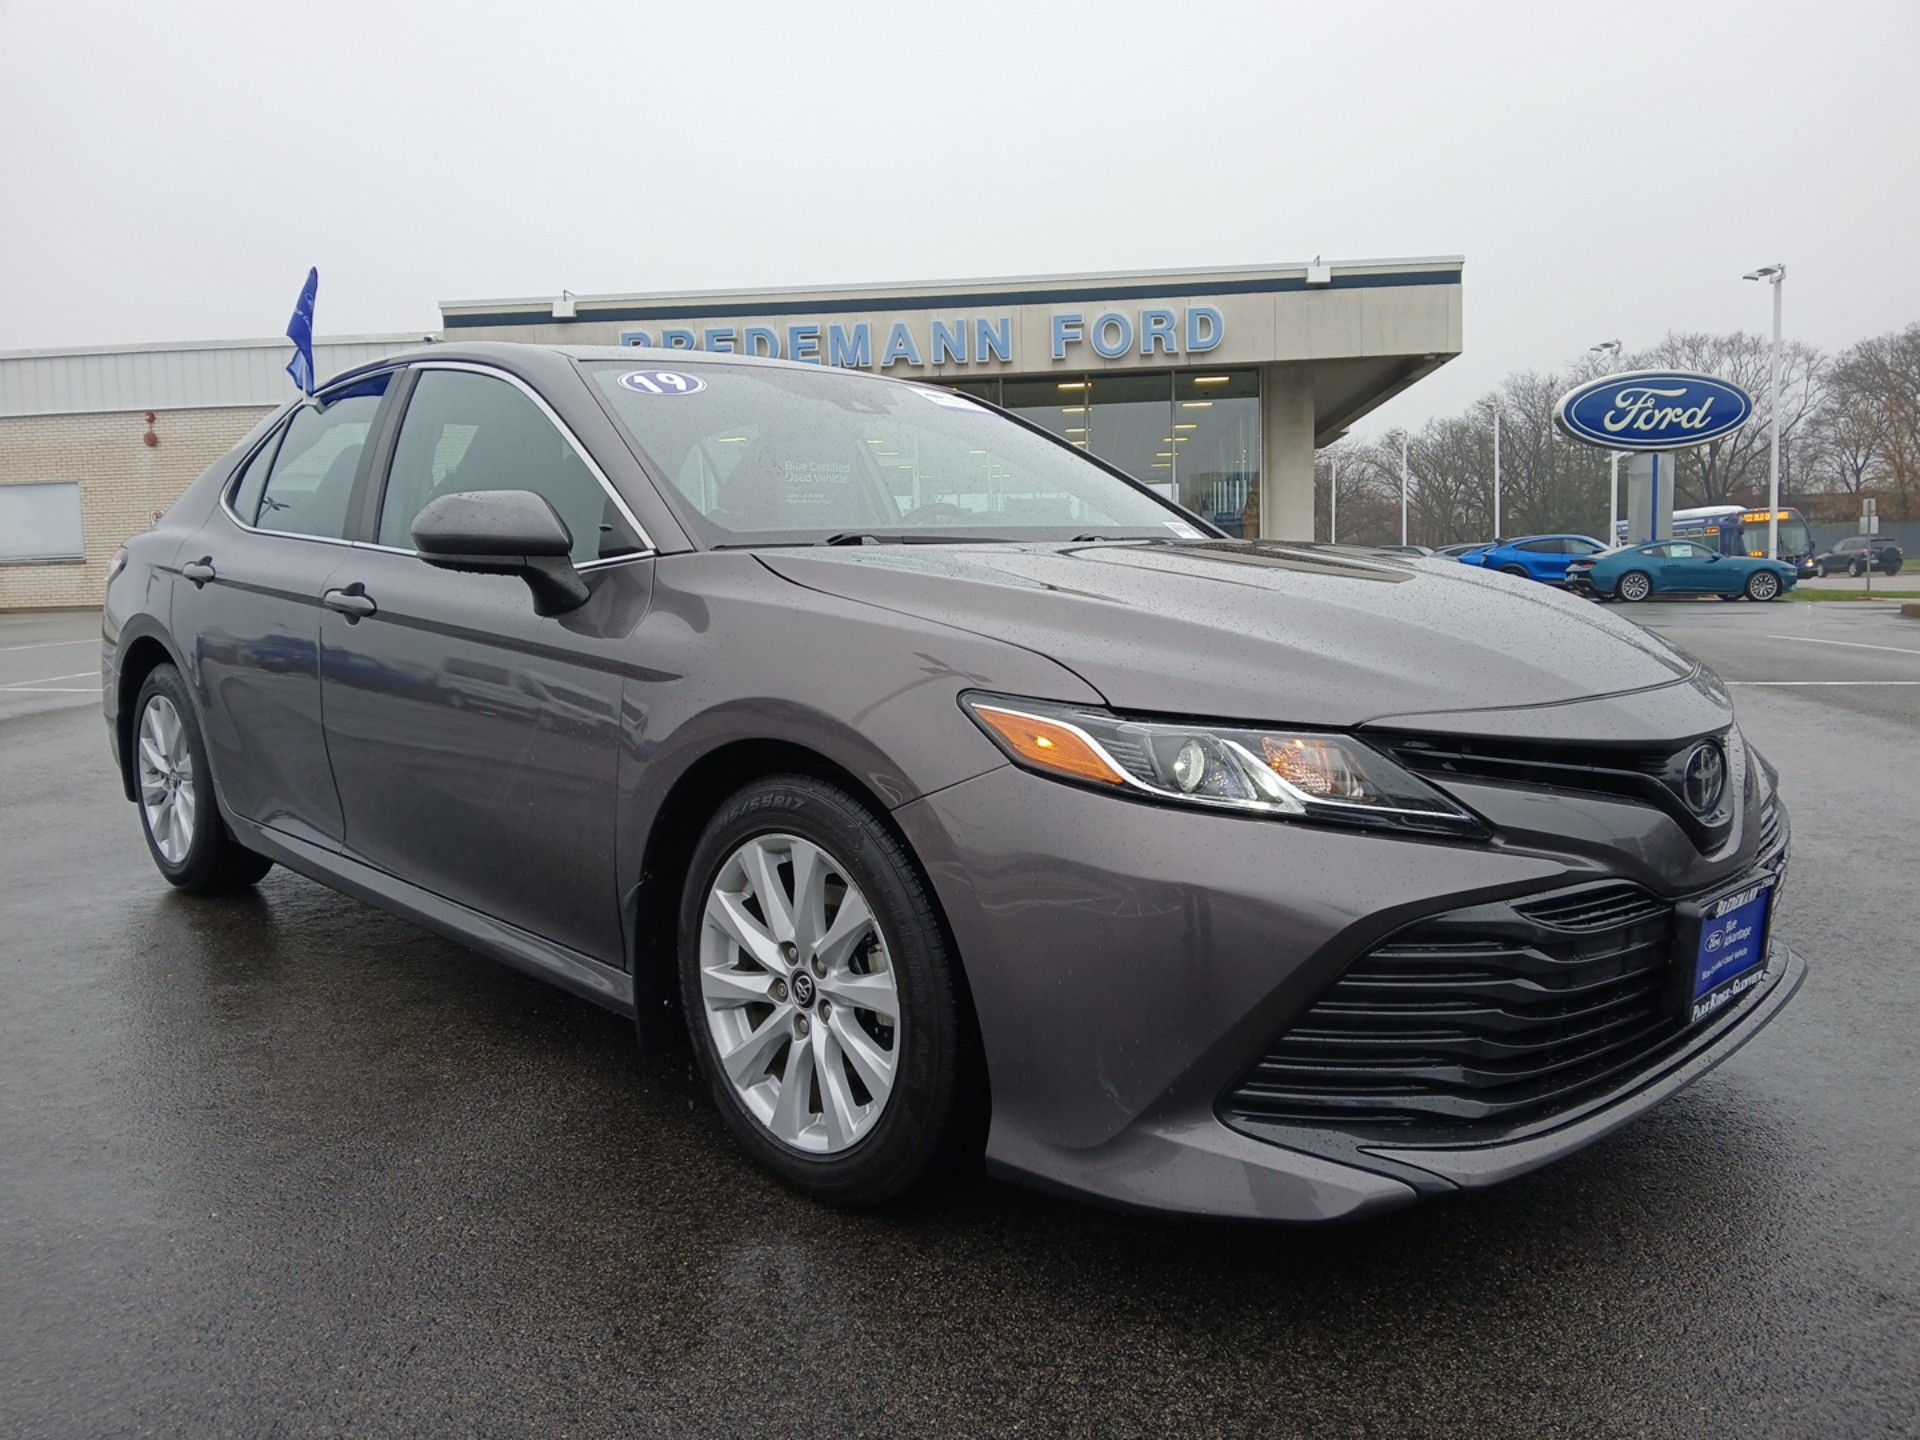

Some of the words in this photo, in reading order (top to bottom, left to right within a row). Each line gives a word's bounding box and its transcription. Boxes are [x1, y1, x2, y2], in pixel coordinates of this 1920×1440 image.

[1051, 304, 1226, 360] FORD
[633, 372, 687, 393] 19
[1603, 387, 1715, 432] Ford
